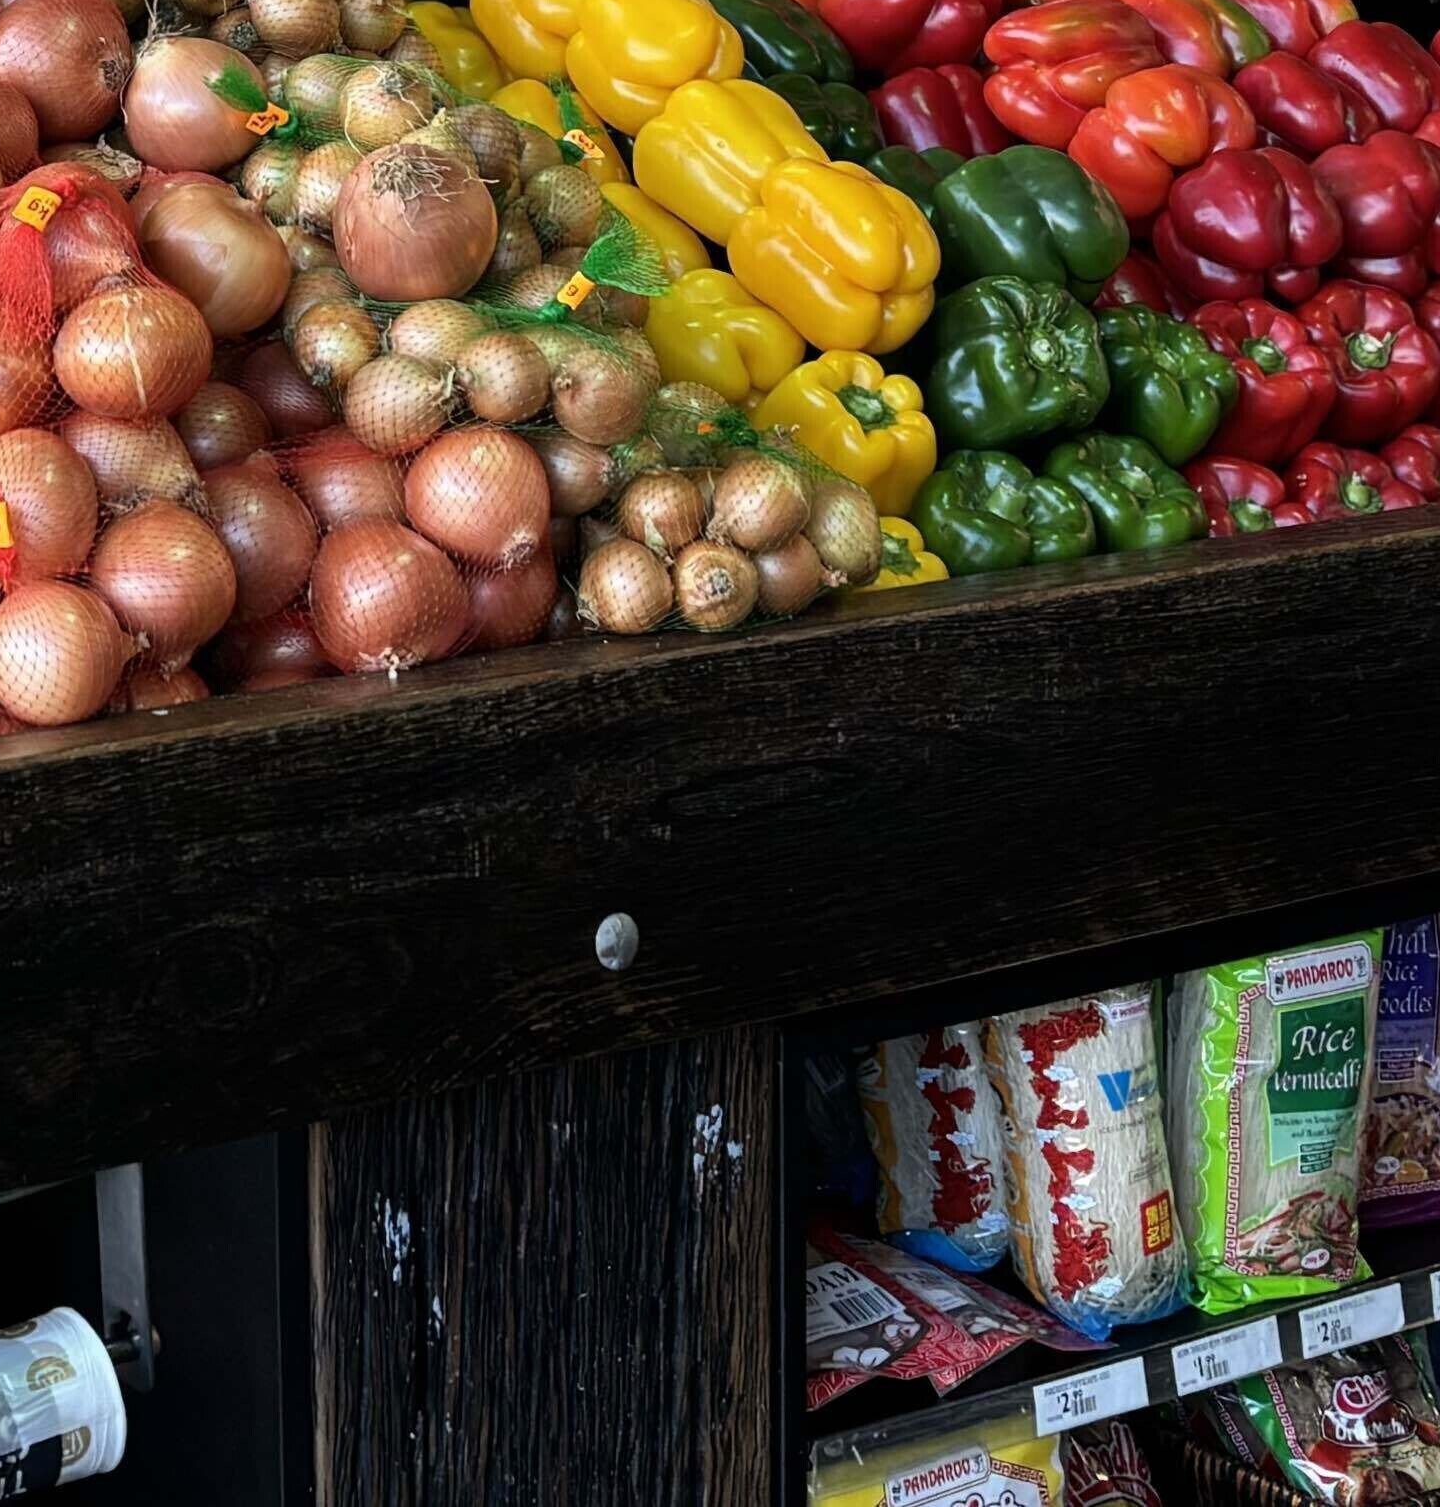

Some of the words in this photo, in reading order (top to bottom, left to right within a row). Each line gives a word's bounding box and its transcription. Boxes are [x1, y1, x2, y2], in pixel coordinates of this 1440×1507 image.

[1285, 957, 1354, 989] PANDAROO
[1382, 961, 1418, 982] Rice
[1379, 986, 1434, 1014] oodles
[1292, 1022, 1356, 1061] Rice
[1274, 1059, 1362, 1092] Vermicelli
[903, 1456, 972, 1496] PANDAROO
